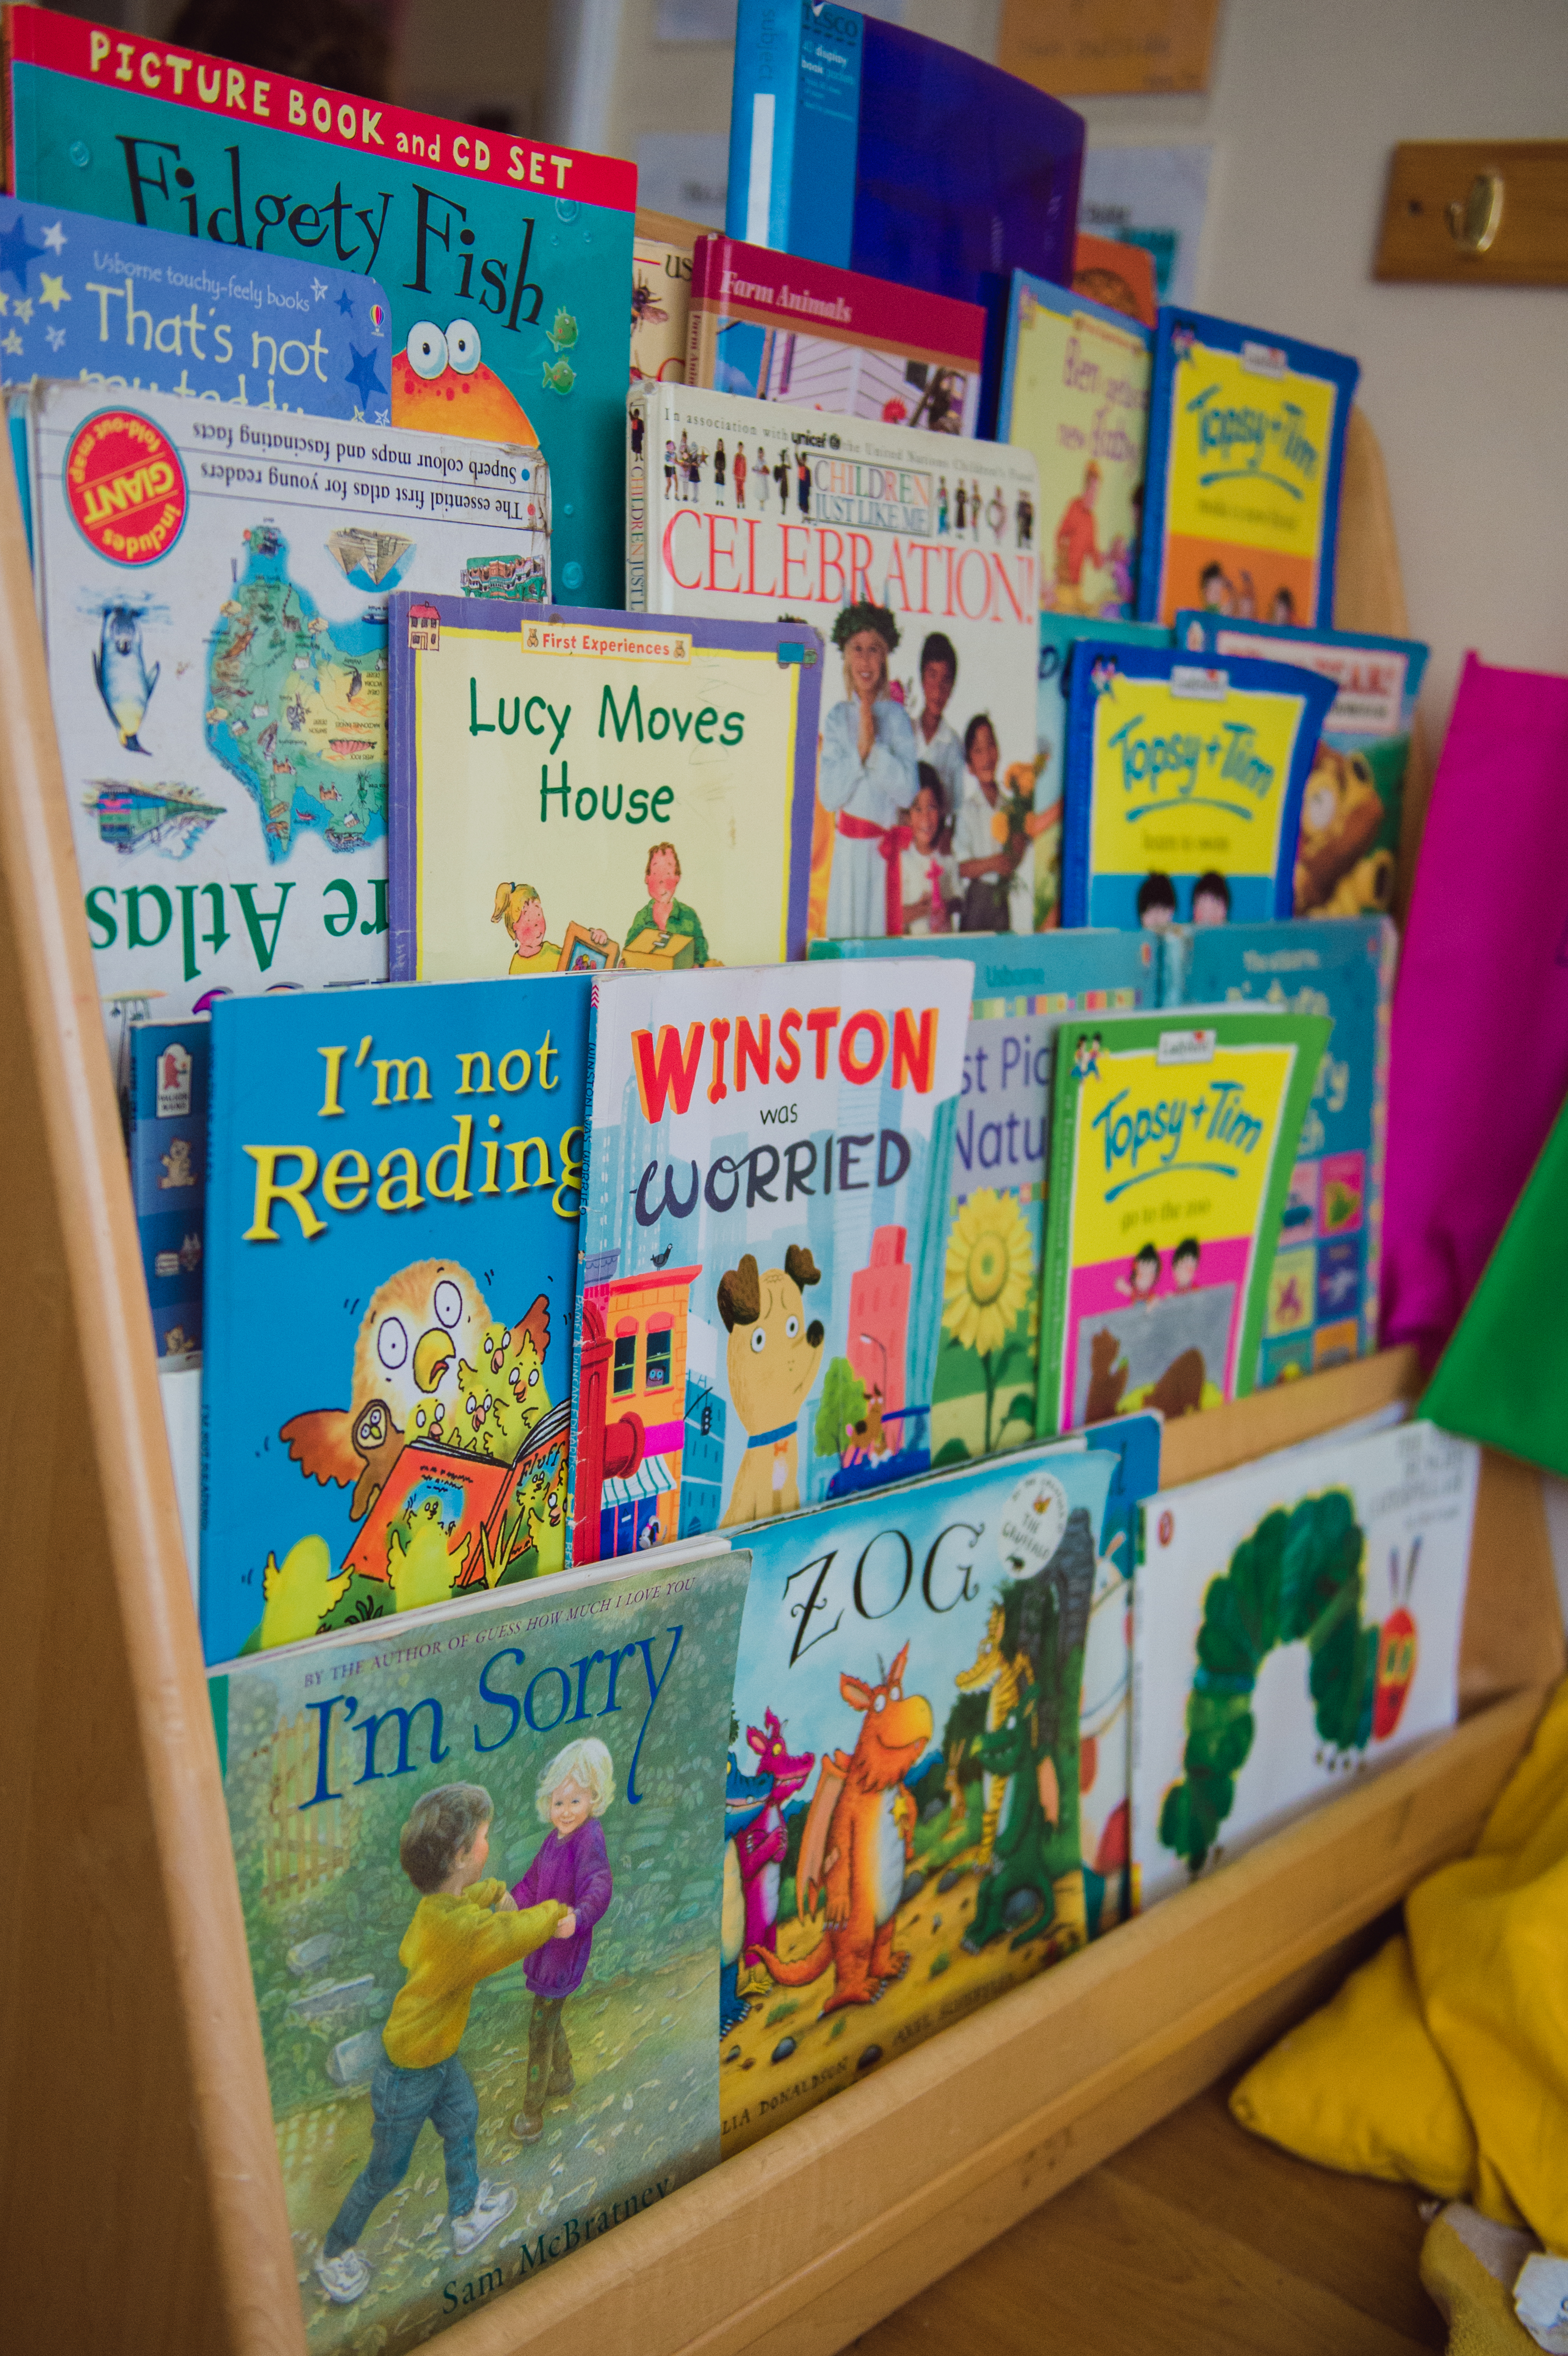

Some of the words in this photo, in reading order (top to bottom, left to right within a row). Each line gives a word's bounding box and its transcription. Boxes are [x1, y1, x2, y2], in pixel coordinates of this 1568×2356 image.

[90, 30, 271, 117] PICTURE
[289, 89, 385, 146] BOOK
[396, 132, 441, 162] and
[453, 136, 490, 171] CD
[507, 146, 573, 189] SET
[115, 135, 394, 275] Fidgety
[402, 183, 544, 332] Fish
[93, 250, 162, 282] Usborne
[166, 266, 262, 309] touchy-feely
[267, 285, 310, 312] books
[719, 270, 774, 304] Farm
[775, 284, 853, 323] Animals
[86, 278, 234, 363] That's
[252, 328, 328, 382] not
[69, 434, 95, 483] map
[193, 423, 233, 449] facts
[240, 424, 329, 461] fascinating
[337, 443, 365, 462] and
[372, 444, 411, 465] maps
[665, 408, 680, 422] In
[686, 415, 757, 435] association
[763, 427, 788, 441] with
[791, 429, 827, 447] unicef
[865, 442, 902, 460] United
[907, 451, 949, 469] Nations
[201, 462, 262, 487] readers
[268, 466, 318, 489] young
[325, 479, 347, 500] for
[417, 454, 463, 476] colour
[469, 460, 516, 484] Superb
[814, 460, 930, 507] CHILDREN
[83, 461, 175, 524] GIANT
[354, 482, 390, 503] atlas
[396, 488, 425, 509] first
[431, 492, 490, 512] essential
[495, 500, 523, 520] The
[630, 466, 644, 556] CHILDREN
[813, 492, 855, 526] JUST
[858, 498, 899, 528] LIKE
[902, 507, 929, 534] ME
[626, 559, 645, 595] JUST
[662, 509, 1035, 626] CELEBRATION!
[542, 633, 577, 650] First
[583, 635, 670, 657] Experiences
[469, 677, 571, 755] Lucy
[598, 685, 746, 746] Moves
[540, 760, 674, 823] House
[84, 882, 297, 982] Atlas
[317, 1035, 433, 1117] I'm
[455, 1029, 560, 1095] not
[585, 1042, 597, 1108] WINSTON
[630, 1006, 940, 1125] WINSTON
[759, 1103, 799, 1126] was
[242, 1114, 584, 1240] Reading
[629, 1128, 911, 1227] WORRIED
[570, 1352, 581, 1404] DUNCAN
[516, 1440, 566, 1486] Fluff
[782, 1521, 986, 1670] ZOG
[303, 1671, 324, 1689] BY
[330, 1661, 365, 1681] THE
[371, 1640, 443, 1671] AUTHOR
[447, 1633, 471, 1651] OF
[476, 1619, 523, 1644] GUESS
[525, 1609, 565, 1633] HOW
[566, 1598, 612, 1619] MUCH
[614, 1594, 624, 1609] I
[624, 1585, 662, 1607] LOVE
[666, 1576, 697, 1596] YOU
[298, 1695, 450, 1812] I'm
[474, 1624, 684, 1806] Sorry
[758, 2056, 848, 2117] DONALDSON
[442, 2266, 506, 2316] Sam
[517, 2175, 672, 2277] McBratney
